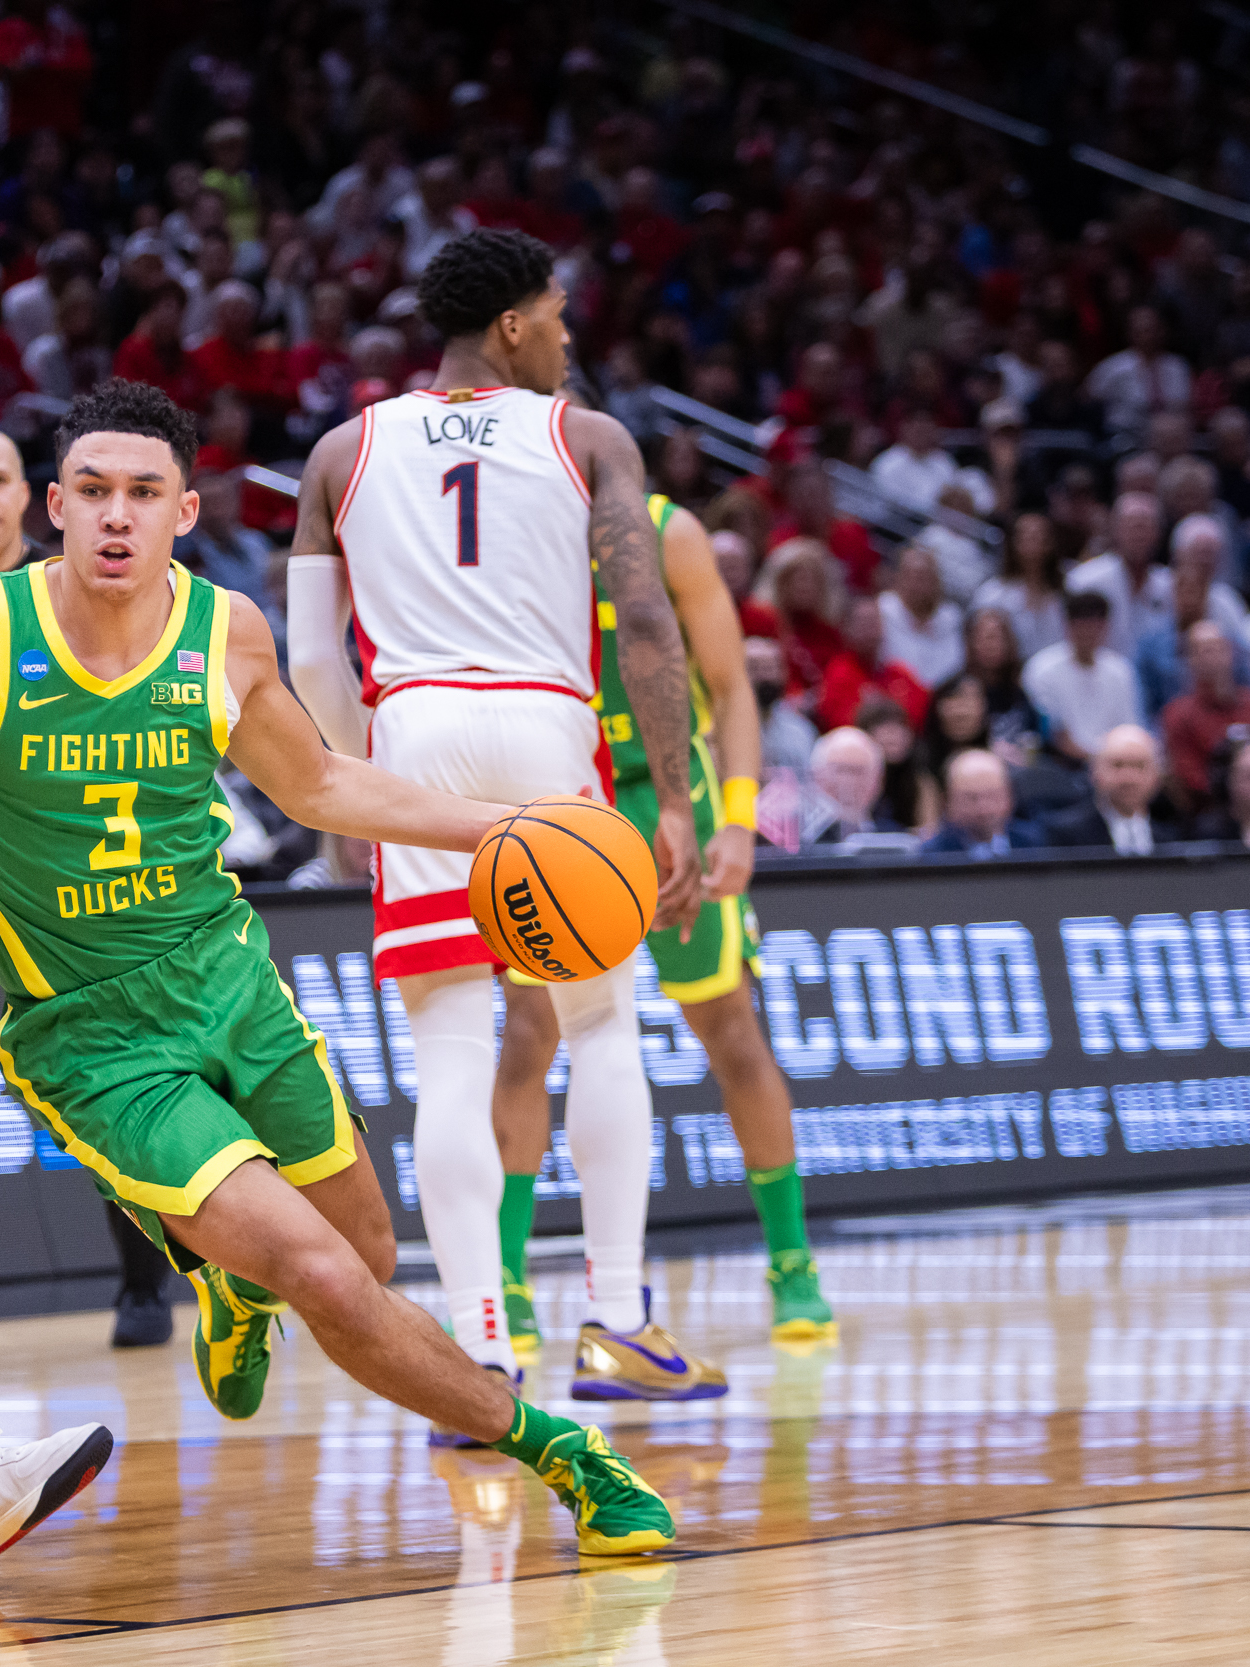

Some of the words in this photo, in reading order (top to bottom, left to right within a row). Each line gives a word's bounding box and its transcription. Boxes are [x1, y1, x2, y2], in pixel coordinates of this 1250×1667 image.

[423, 414, 499, 446] LOVE
[441, 461, 479, 567] 1
[21, 664, 47, 674] NCAA
[19, 728, 189, 772] FIGHTING
[83, 782, 141, 871] 3
[56, 865, 177, 919] DUCKS
[503, 877, 578, 981] Wilson
[634, 920, 1052, 1087] SCOND
